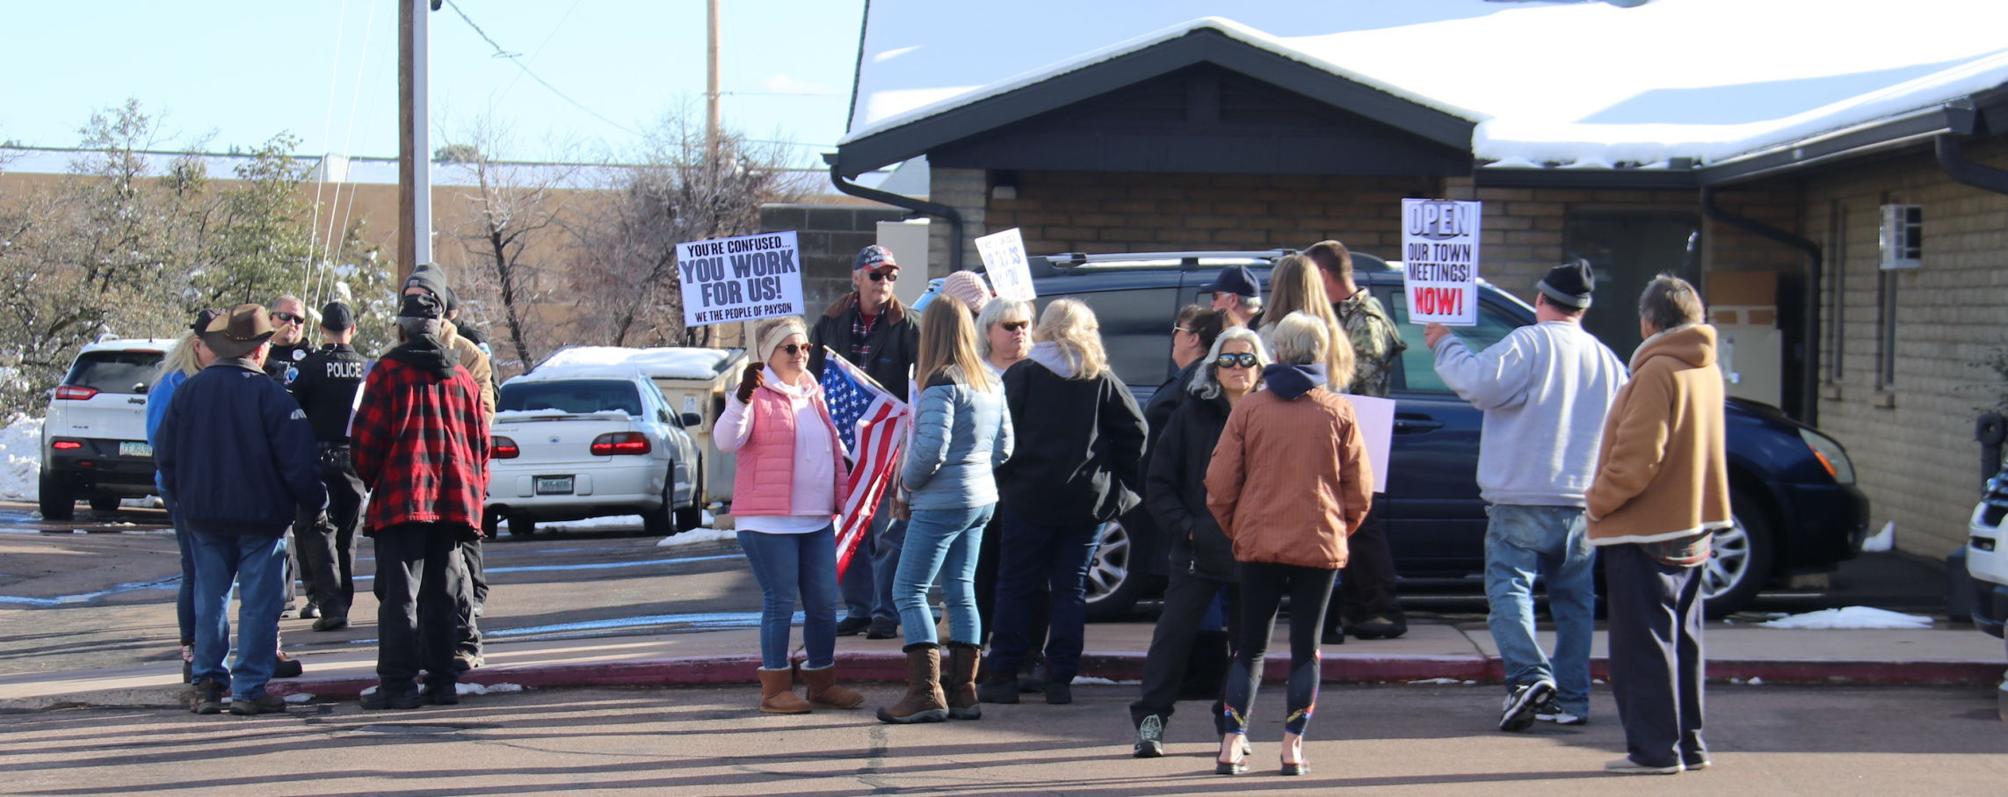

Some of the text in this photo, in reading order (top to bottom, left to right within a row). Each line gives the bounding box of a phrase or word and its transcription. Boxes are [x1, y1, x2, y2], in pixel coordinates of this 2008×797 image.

[1408, 203, 1471, 237] OPEN
[687, 241, 723, 258] YOU'RE
[1408, 243, 1471, 262] OUR TOWN
[680, 249, 796, 284] YOU WORK
[1408, 263, 1470, 282] MEETINGS!
[701, 276, 782, 307] FOR US!
[1414, 286, 1463, 316] NOW!
[695, 302, 792, 322] WE THE PEOPLE OF PAYSON
[326, 362, 362, 378] POLICE
